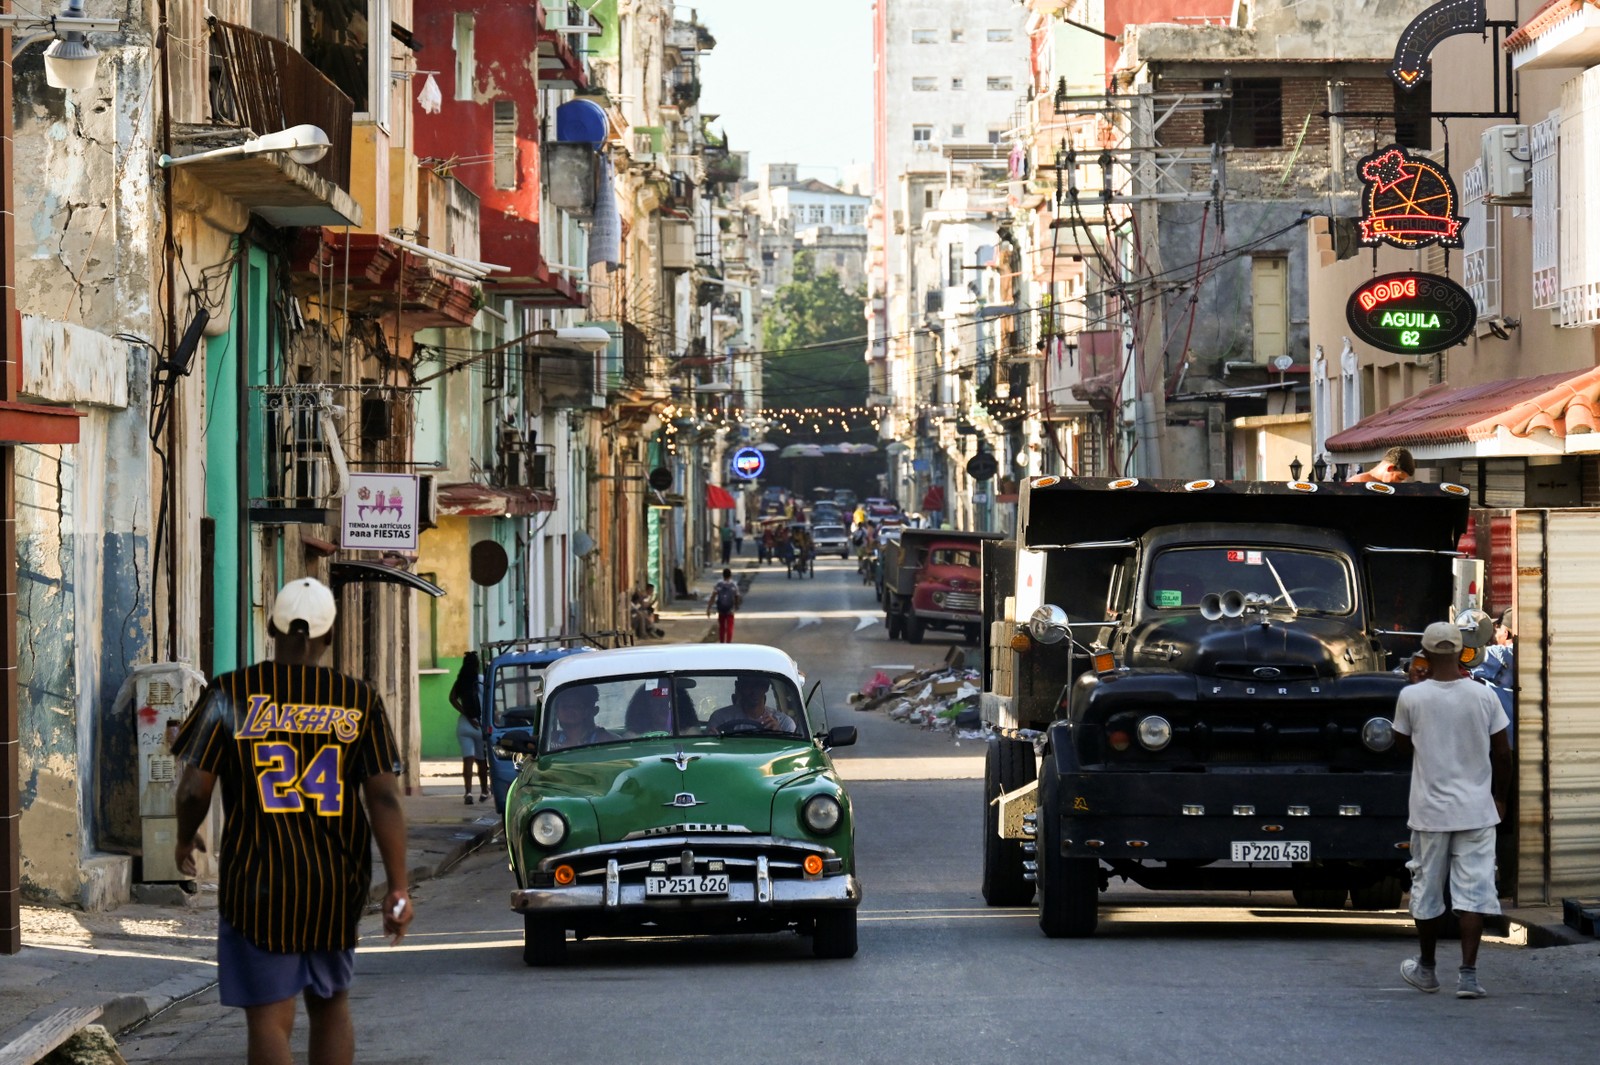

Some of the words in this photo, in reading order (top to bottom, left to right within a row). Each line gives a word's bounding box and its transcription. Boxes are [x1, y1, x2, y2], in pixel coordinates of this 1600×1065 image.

[1406, 7, 1470, 53] Pizzeria
[1381, 312, 1440, 328] AGUILA
[1401, 330, 1420, 345] 62
[373, 529, 410, 539] FIESTAS
[253, 741, 345, 817] 24
